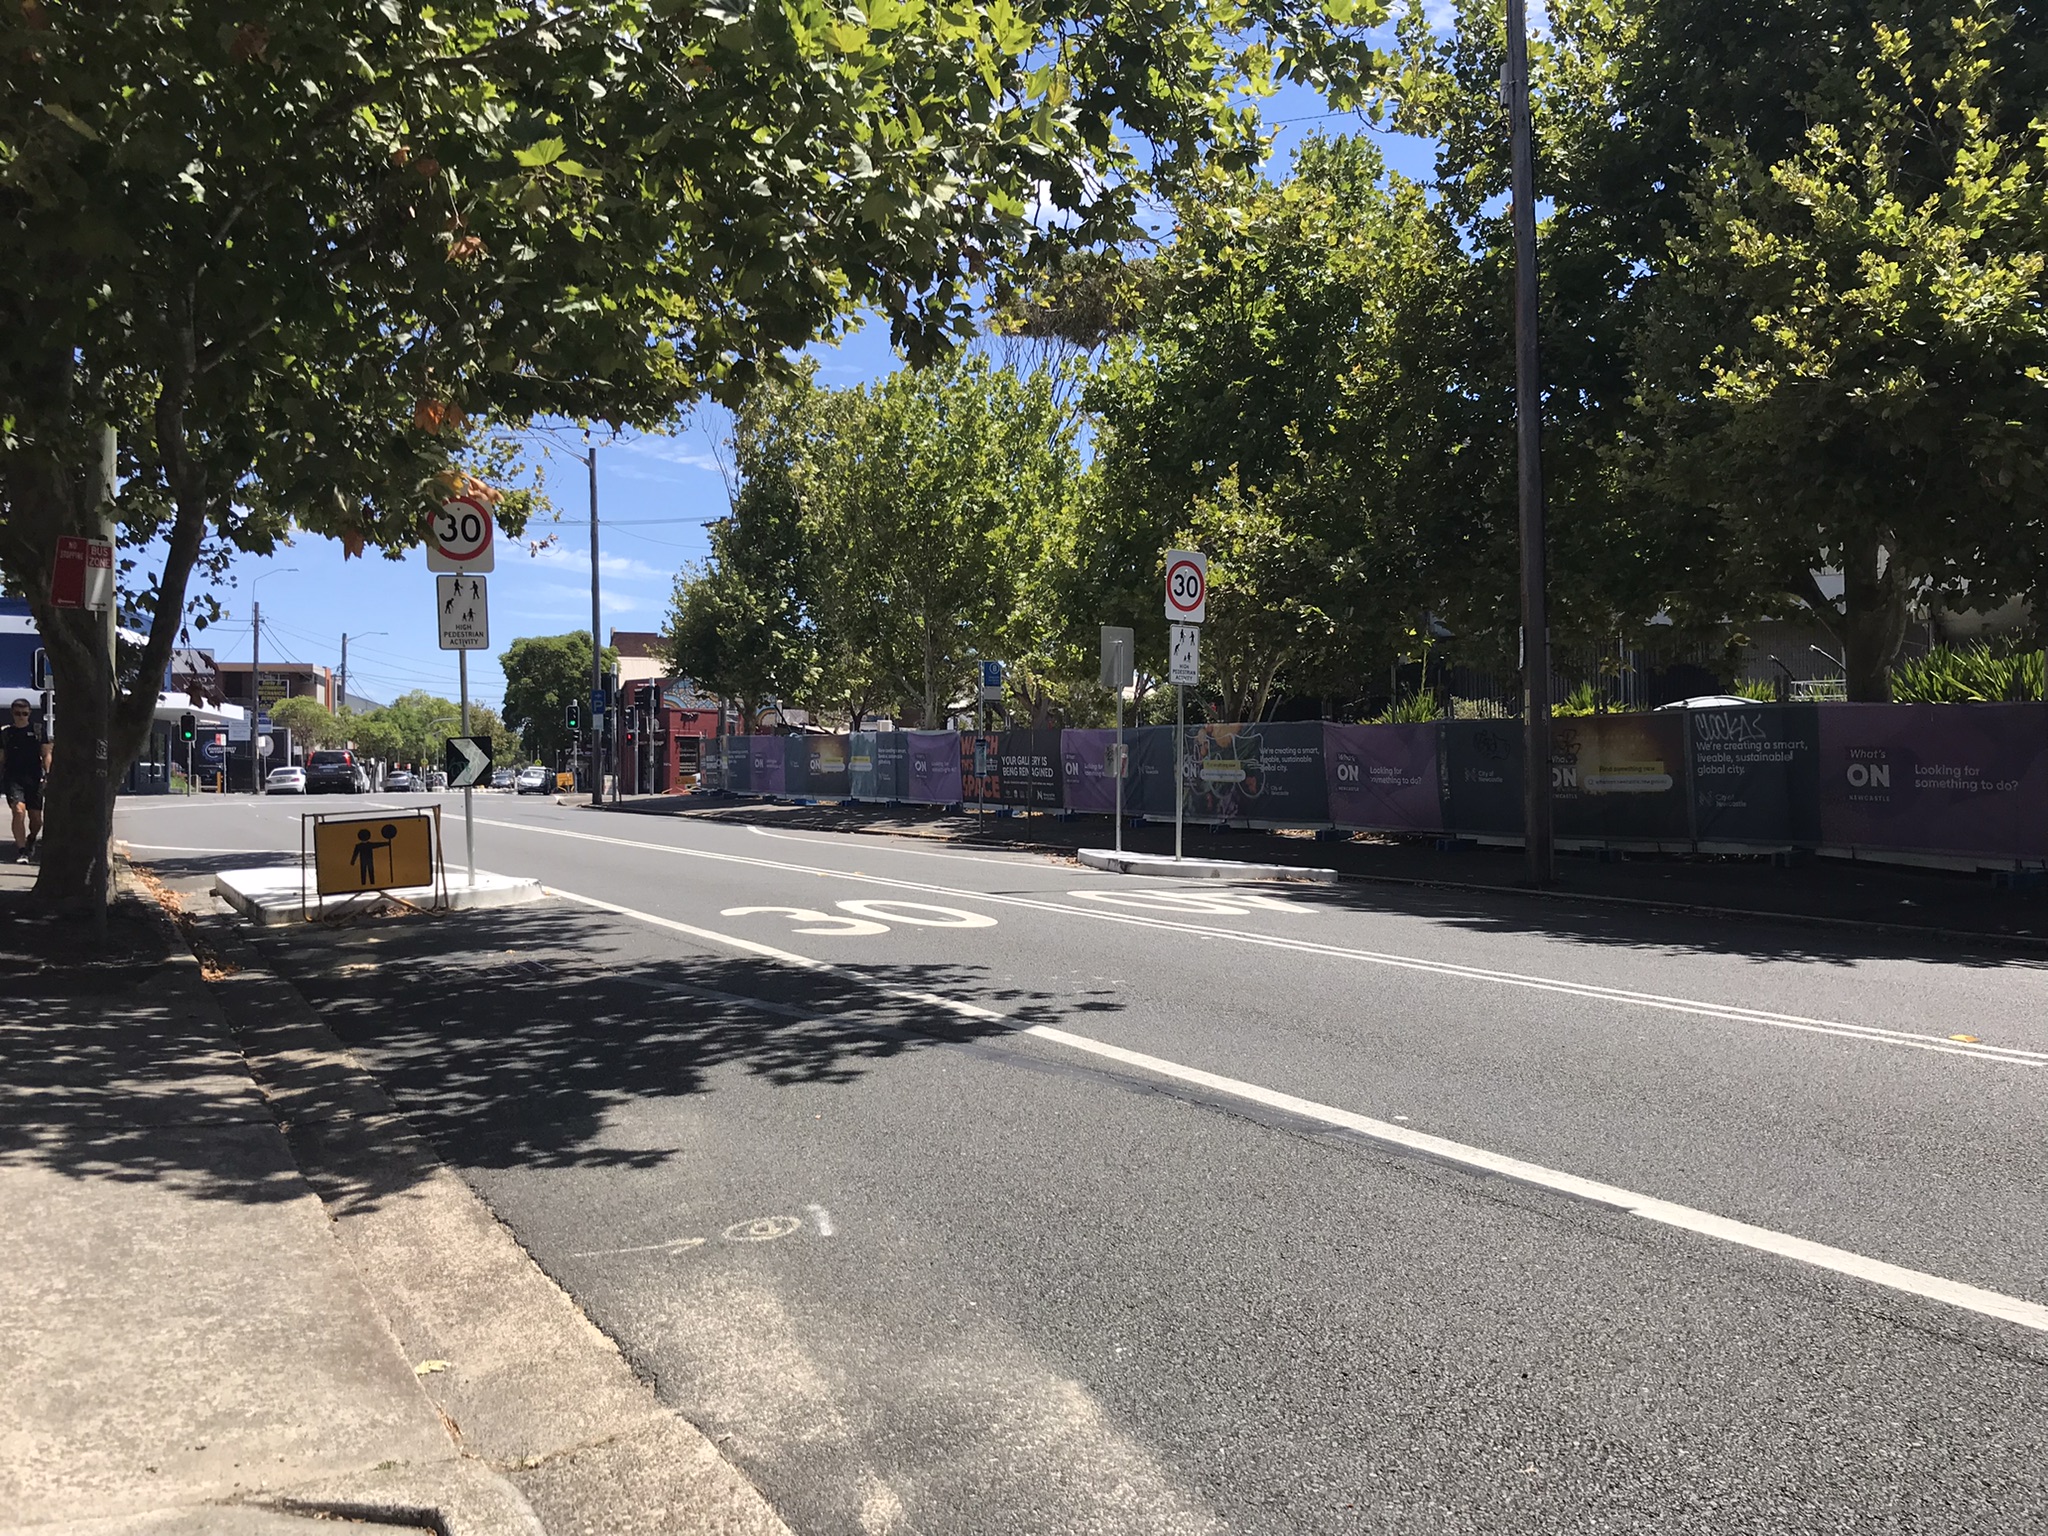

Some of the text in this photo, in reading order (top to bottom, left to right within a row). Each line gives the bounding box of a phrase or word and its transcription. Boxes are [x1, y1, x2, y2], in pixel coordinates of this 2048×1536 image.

[439, 514, 481, 543] 30
[90, 545, 109, 557] BUS
[88, 557, 111, 568] ZONE
[1173, 574, 1199, 598] 30
[449, 638, 479, 646] ACTIVITY
[593, 700, 603, 711] P
[961, 735, 999, 755] WACH
[1696, 740, 1808, 752] We're creating a smart,
[1274, 747, 1296, 756] creating
[1302, 747, 1320, 755] smart,
[1697, 751, 1793, 763] liveable, sustainable
[1849, 749, 1886, 759] What's
[754, 759, 764, 769] ON
[810, 759, 820, 770] ON
[1001, 755, 1017, 766] YOUR
[1041, 756, 1049, 766] IS
[1281, 755, 1312, 763] sustainable
[914, 760, 927, 772] ON
[1002, 766, 1018, 776] BEING
[1065, 762, 1079, 776] ON
[1183, 762, 1197, 778] ON
[1277, 764, 1288, 773] city.
[1369, 766, 1402, 776] Looking for
[1697, 764, 1745, 776] global city.
[1914, 764, 1980, 778] Looking for
[1336, 764, 1359, 781] ON
[1847, 763, 1890, 788] ON
[962, 774, 1000, 798] SPACE
[1410, 777, 1422, 785] do?
[1914, 777, 2019, 792] something to do?
[1849, 794, 1890, 802] NEWCASTLE
[720, 899, 998, 936] 30
